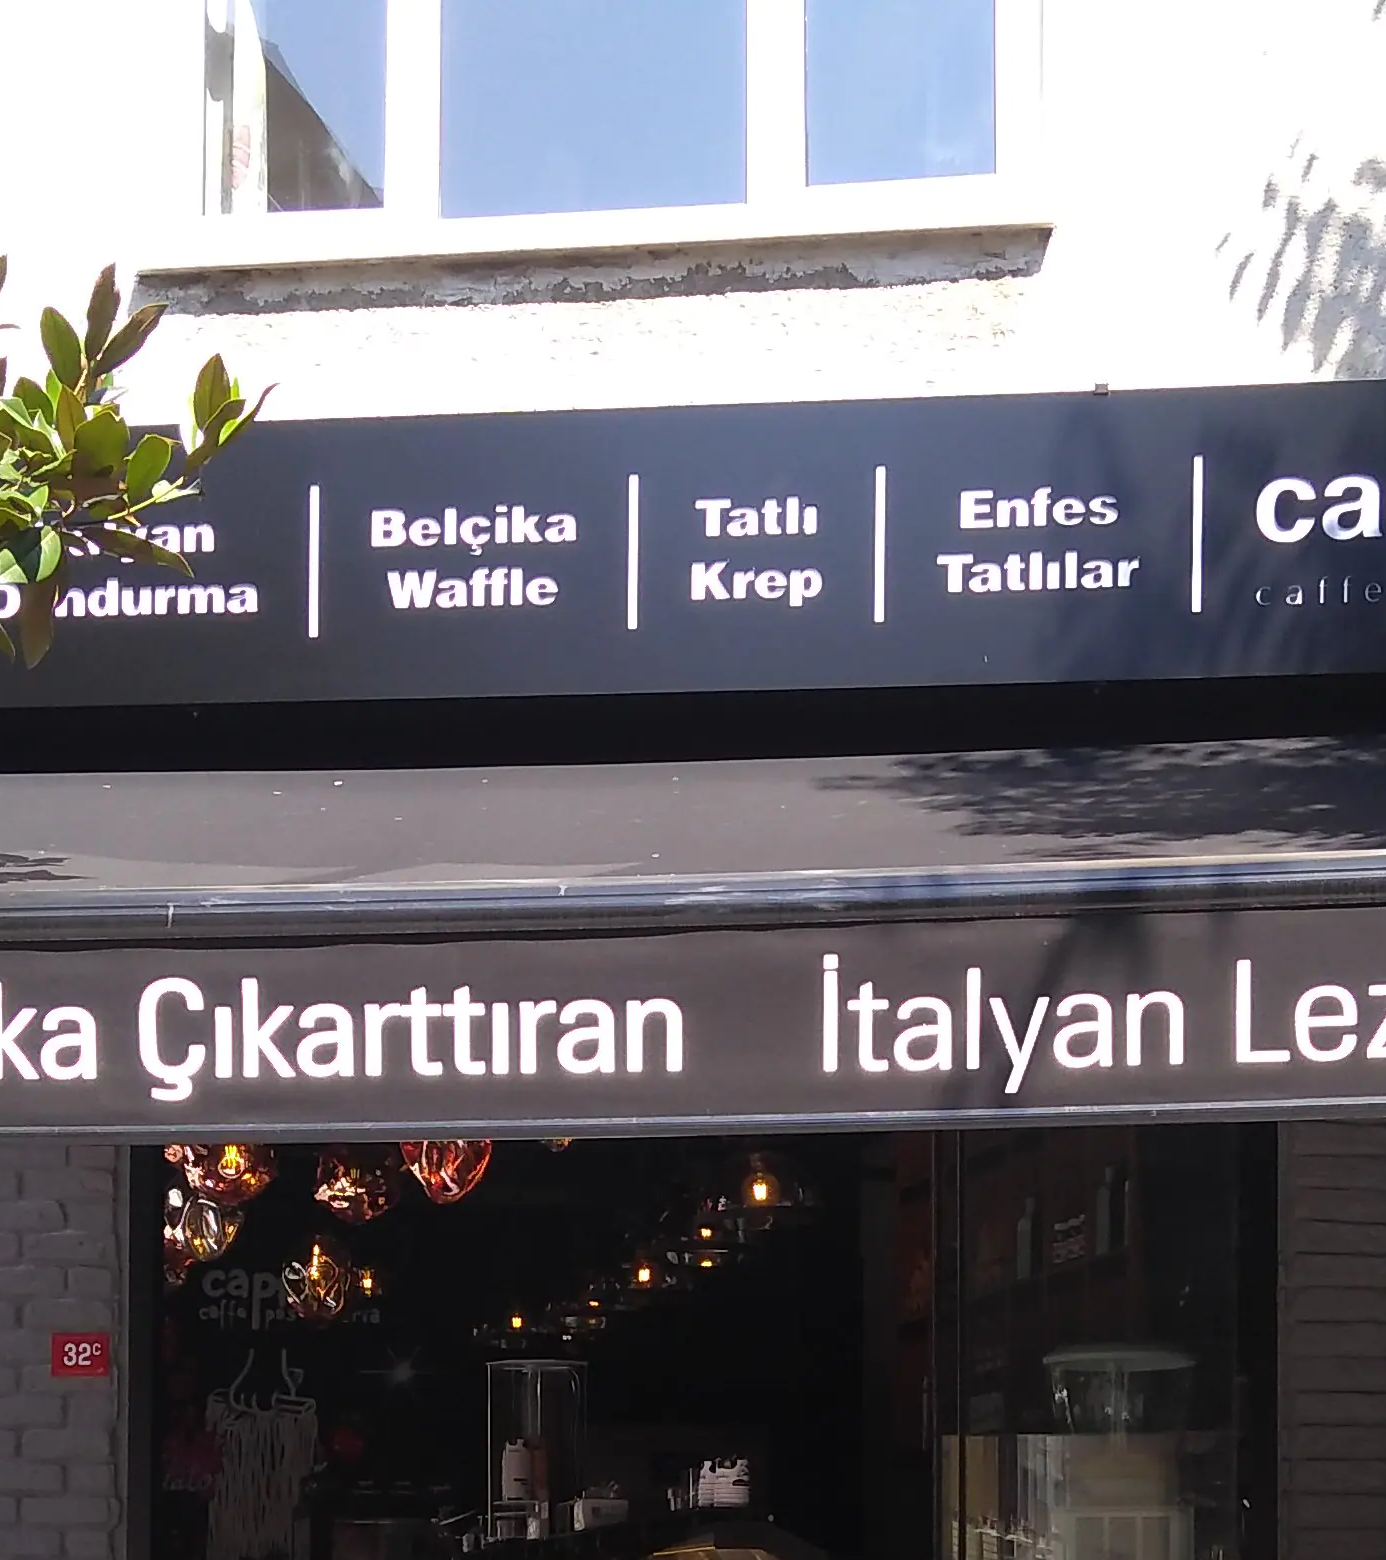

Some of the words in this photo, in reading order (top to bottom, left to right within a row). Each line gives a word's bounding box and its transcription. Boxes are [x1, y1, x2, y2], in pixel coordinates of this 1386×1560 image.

[694, 496, 819, 538] Tatlı
[959, 487, 1118, 530] Enfes
[370, 504, 578, 561] Belçika
[387, 567, 560, 609] Waffle
[690, 557, 824, 608] Krep
[936, 551, 1141, 594] Tatlılar
[1255, 574, 1382, 608] caffe
[137, 976, 684, 1103] Çıkarttıran
[821, 952, 1186, 1095] İtalyan
